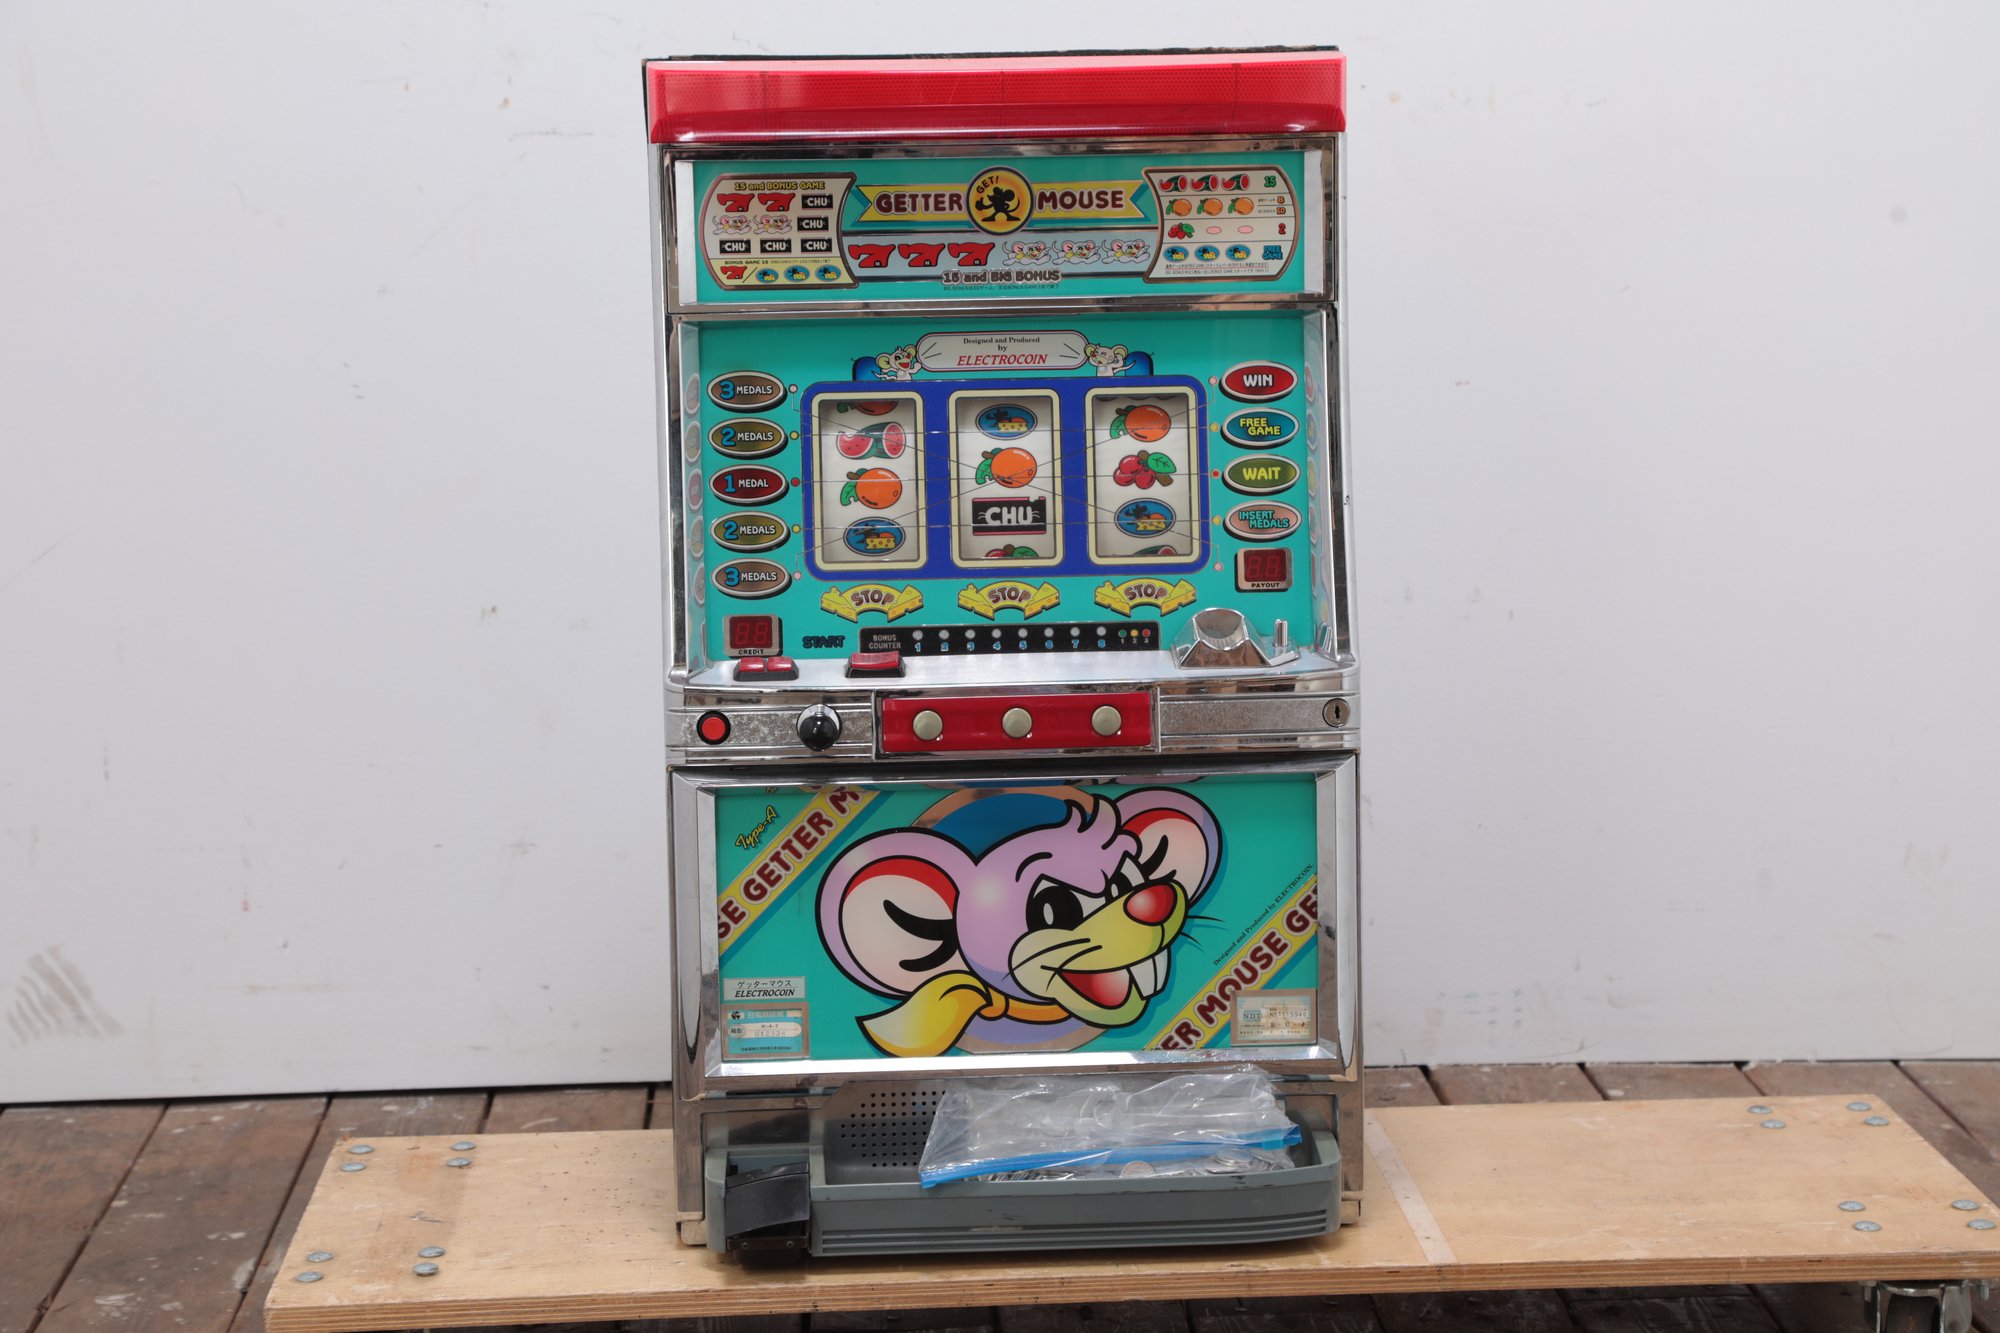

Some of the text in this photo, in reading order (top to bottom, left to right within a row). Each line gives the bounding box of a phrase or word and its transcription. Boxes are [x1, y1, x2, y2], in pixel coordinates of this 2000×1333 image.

[734, 181, 825, 191] 15 and BONUS GAME
[976, 175, 999, 194] GET!
[1264, 175, 1276, 188] 15
[806, 197, 828, 207] CHU
[875, 189, 1124, 214] GETTER MOUSE
[1276, 207, 1286, 215] 10
[802, 220, 824, 229] CHU
[1278, 223, 1286, 235] 2
[724, 241, 827, 252] CHU CHU CHU
[1263, 245, 1281, 253] FREE
[1262, 252, 1283, 260] GAME
[943, 271, 960, 283] 15
[963, 271, 986, 283] and
[1015, 270, 1060, 282] BONUS
[963, 337, 993, 345] Designed
[998, 344, 1007, 352] by
[957, 353, 1048, 366] ELECTROCOIN
[1242, 374, 1273, 387] WIN
[720, 380, 773, 400] 3 MEDALS
[1239, 418, 1268, 427] FREE
[721, 427, 774, 447] 2 MEDALS
[1248, 426, 1281, 436] GAME
[1242, 467, 1281, 480] WAIT
[724, 474, 769, 493] 1 MEDAL
[985, 506, 1033, 525] CHU
[1239, 510, 1274, 521] INSERT
[723, 520, 776, 540] 2 MEDALS
[1249, 518, 1290, 529] MEDALS
[724, 567, 777, 587] 3 MEDALS
[851, 589, 894, 606] STOP
[988, 586, 1031, 603] STOP
[1124, 583, 1168, 601] STOP
[802, 635, 846, 649] START
[873, 634, 897, 642] BONUS
[868, 642, 901, 650] COUNTER
[915, 642, 921, 652] 1
[940, 642, 949, 652] 2
[966, 641, 975, 651] 3
[993, 641, 1001, 651] 4
[1019, 640, 1027, 650] 5
[1071, 639, 1079, 648] 7
[735, 804, 778, 849] Type-A
[743, 811, 834, 901] GETTER
[1213, 864, 1313, 966] Designed and Produced by ELECTROCOIN
[1156, 1020, 1203, 1050] ER
[1196, 930, 1289, 1026] MOUSE
[1285, 885, 1318, 933] GE
[737, 980, 792, 988] ゲッターマウス
[735, 989, 796, 998] ELECTROCOIN
